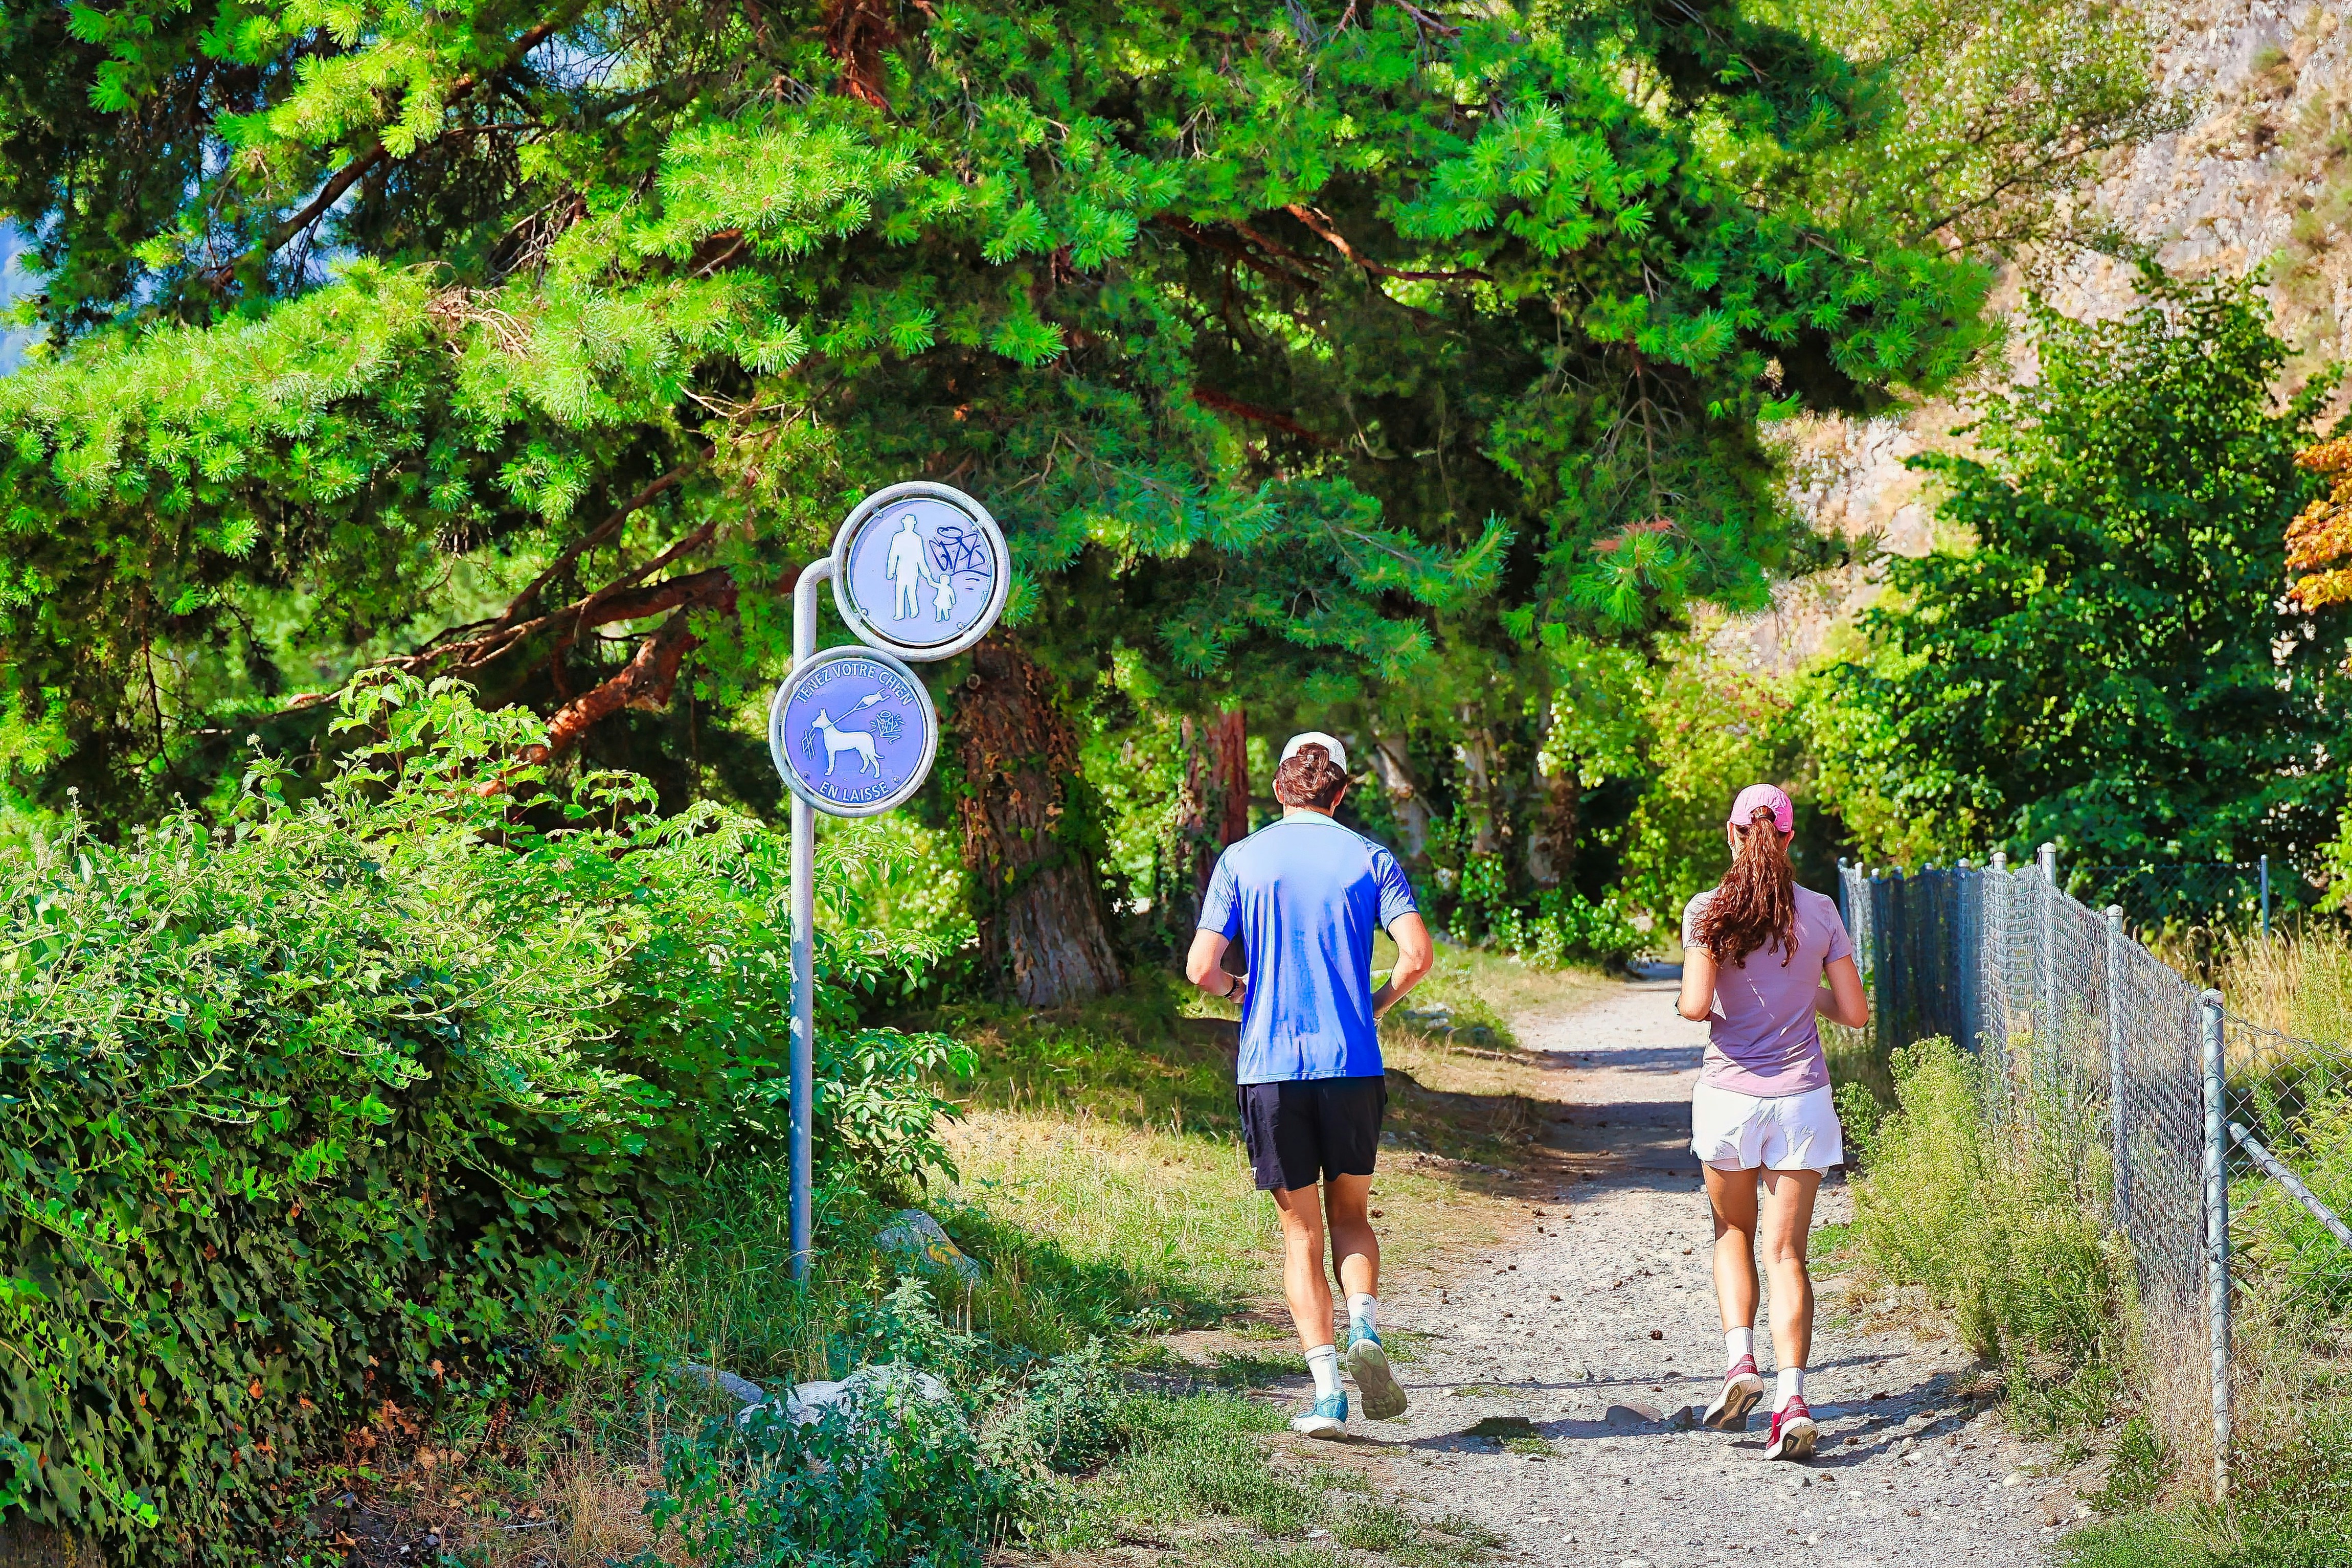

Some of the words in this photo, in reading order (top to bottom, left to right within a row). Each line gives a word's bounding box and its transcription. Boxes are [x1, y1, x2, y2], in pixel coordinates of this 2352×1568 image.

[795, 669, 832, 703] TENEZ
[831, 663, 876, 678] VOTRE
[878, 671, 913, 706] CHIEN
[819, 781, 839, 799] EN
[842, 781, 890, 802] LAISSE
